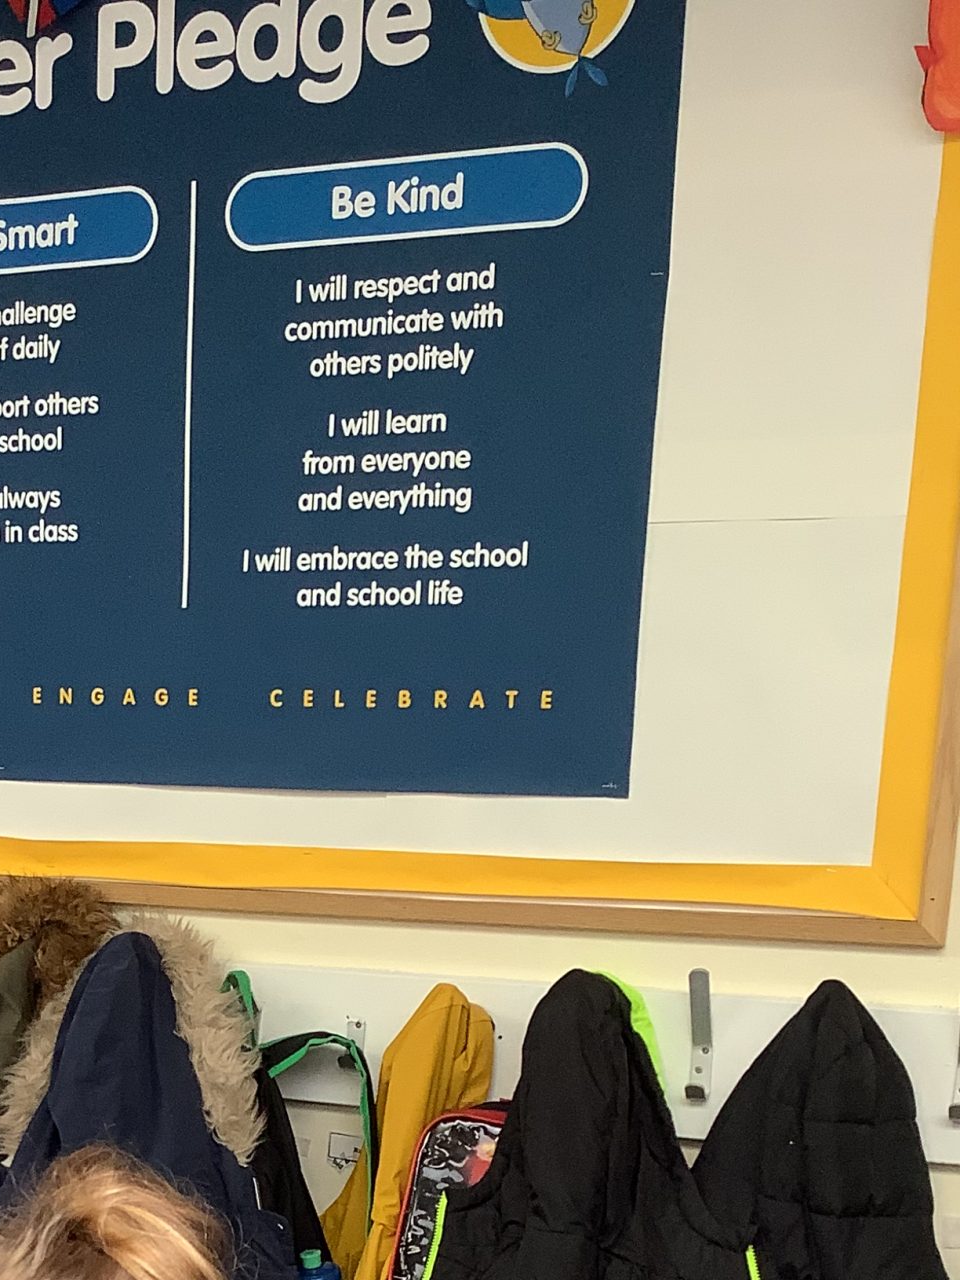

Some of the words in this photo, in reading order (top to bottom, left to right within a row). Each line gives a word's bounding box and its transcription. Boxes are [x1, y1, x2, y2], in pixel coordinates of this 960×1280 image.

[96, 0, 432, 104] Pledge
[331, 185, 376, 220] Be
[386, 171, 465, 216] Kind
[295, 279, 302, 304] I
[308, 273, 348, 303] will
[353, 268, 442, 304] respect
[445, 262, 496, 292] and
[284, 308, 445, 342] communicate
[450, 301, 504, 331] with
[11, 333, 61, 364] daily
[309, 350, 382, 378] others
[387, 341, 475, 380] politely
[34, 391, 99, 417] others
[328, 413, 335, 438] I
[340, 409, 380, 437] will
[385, 408, 447, 435] learn
[301, 449, 355, 476] from
[360, 449, 472, 478] everyone
[297, 484, 343, 512] and
[347, 481, 472, 515] everything
[4, 519, 23, 543] in
[27, 518, 79, 543] class
[242, 548, 250, 573] I
[254, 546, 292, 572] will
[296, 545, 399, 572] embrace
[403, 543, 444, 569] the
[448, 540, 529, 569] school
[296, 581, 342, 607] and
[346, 579, 422, 607] school
[427, 579, 464, 606] life
[32, 686, 199, 706] ENGAGE
[269, 688, 553, 710] CELEBRATE
